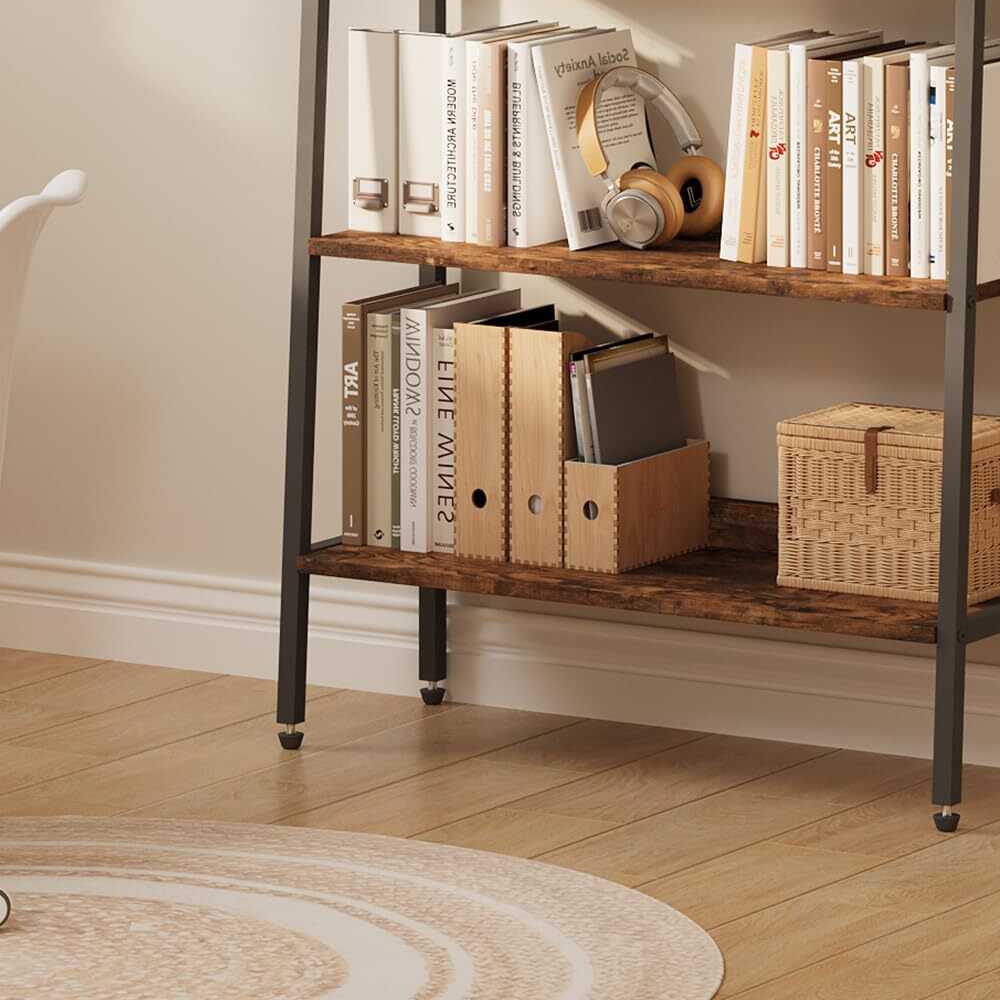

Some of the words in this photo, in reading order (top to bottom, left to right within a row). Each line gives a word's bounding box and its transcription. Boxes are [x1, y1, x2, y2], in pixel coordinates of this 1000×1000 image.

[828, 110, 841, 145] ART
[845, 112, 856, 146] ART
[813, 147, 822, 198] CHARLOTTE
[891, 153, 899, 205] CHARLOTTE
